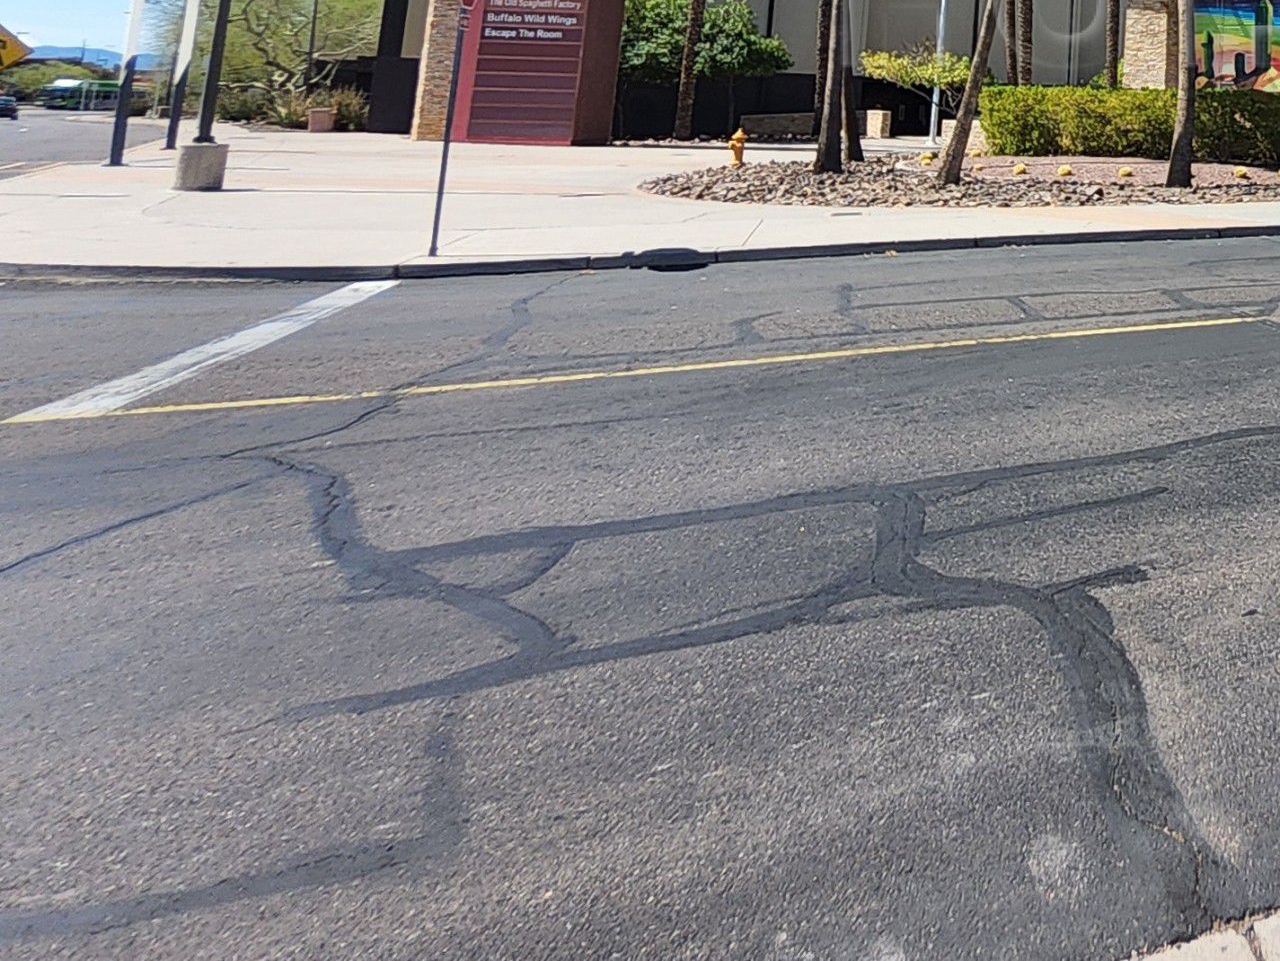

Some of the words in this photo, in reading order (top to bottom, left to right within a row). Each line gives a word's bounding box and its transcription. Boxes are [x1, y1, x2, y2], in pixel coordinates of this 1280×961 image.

[518, 0, 553, 9] Spaghetti
[554, 0, 582, 10] Factory
[487, 13, 522, 22] Buffalo
[524, 14, 546, 23] Wild
[547, 15, 578, 26] Wings
[484, 28, 517, 38] Escape
[519, 29, 535, 38] The
[537, 29, 563, 39] Room
